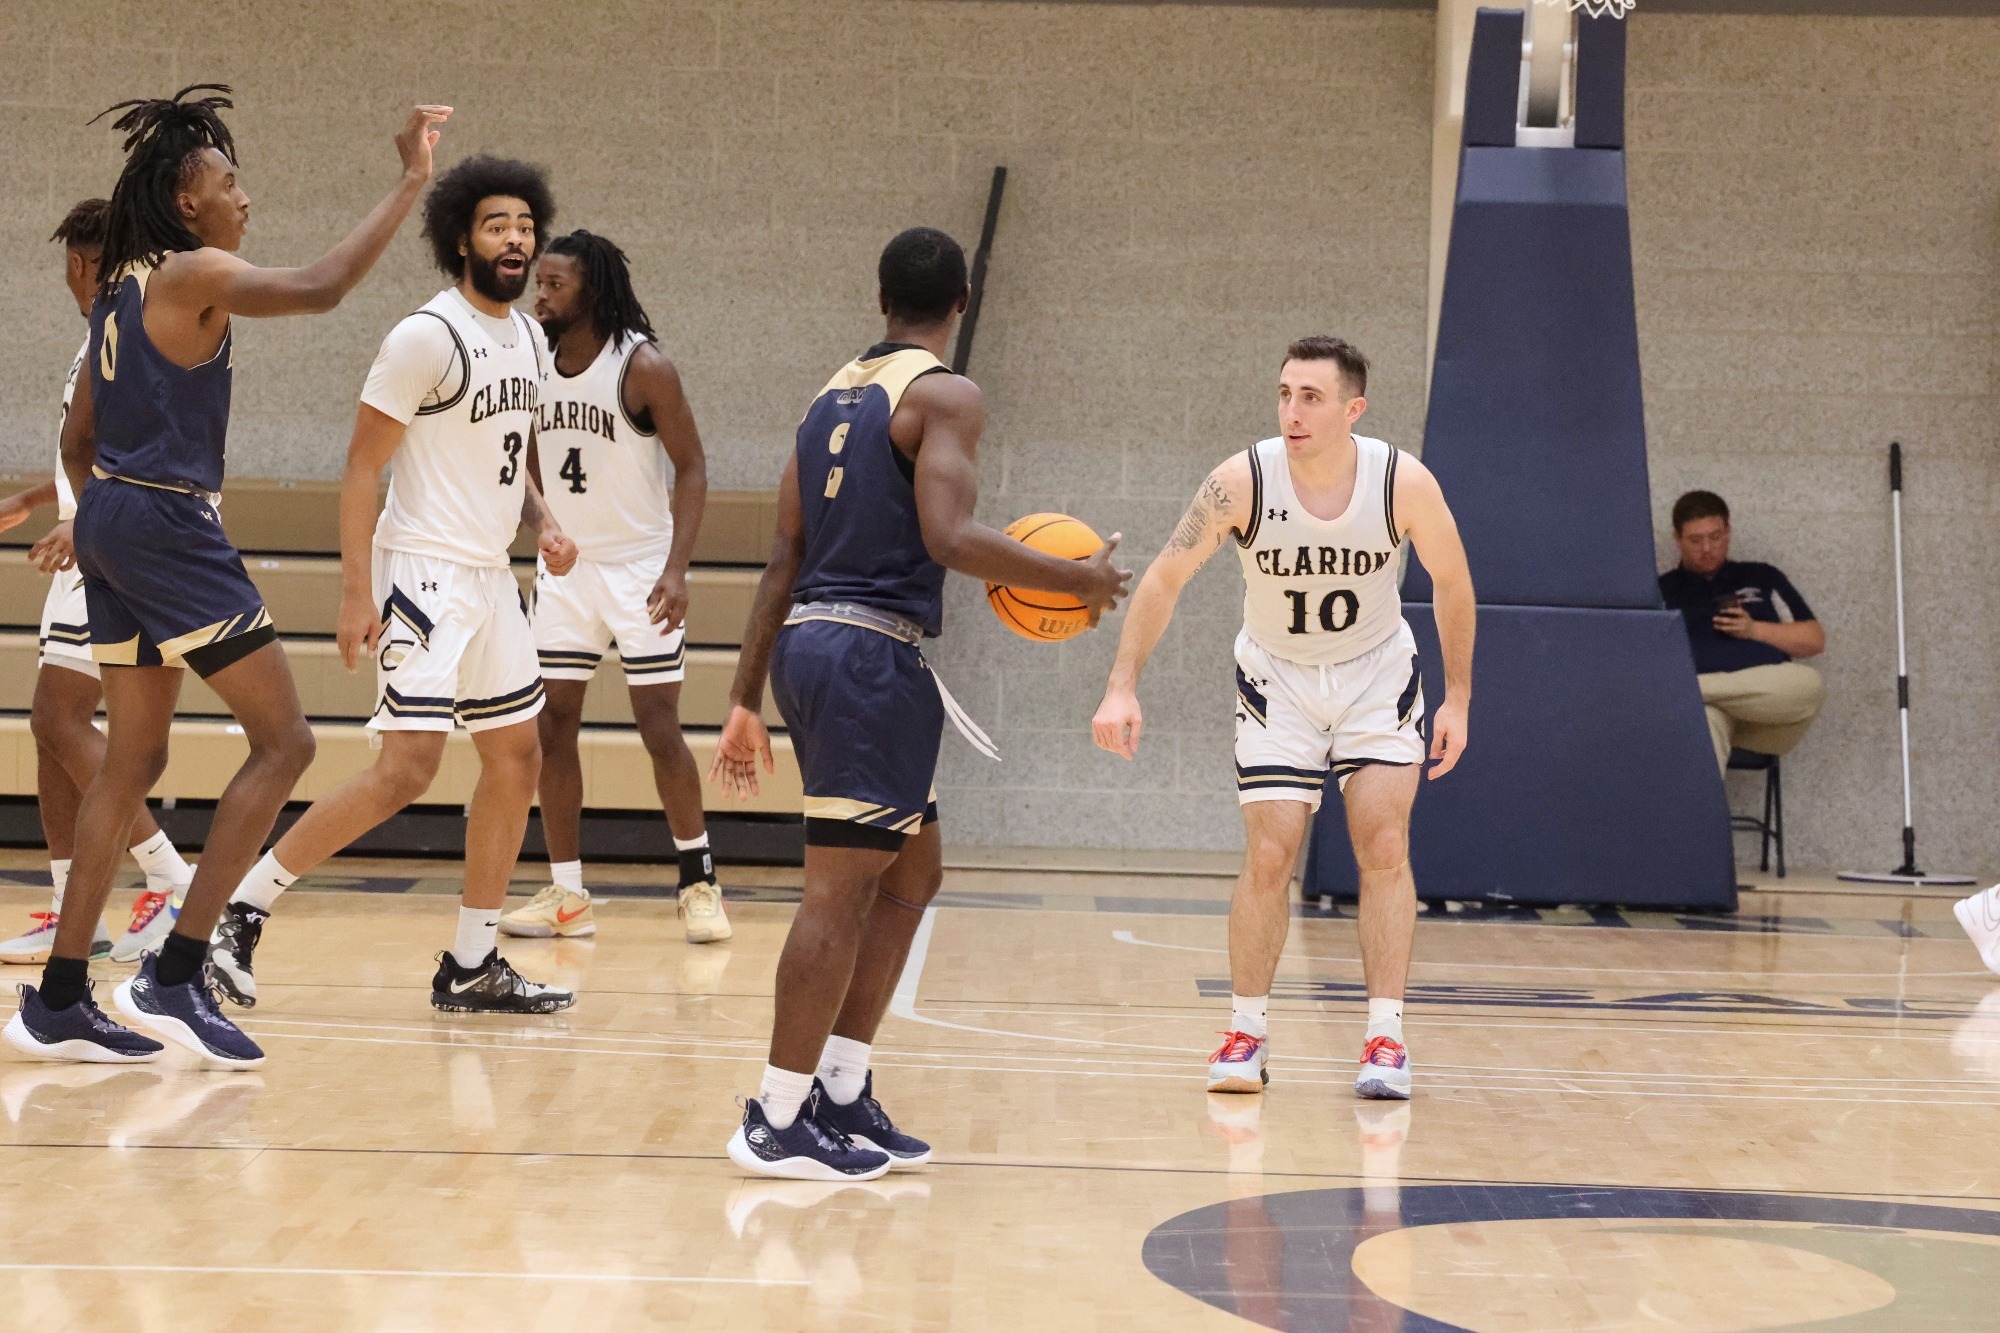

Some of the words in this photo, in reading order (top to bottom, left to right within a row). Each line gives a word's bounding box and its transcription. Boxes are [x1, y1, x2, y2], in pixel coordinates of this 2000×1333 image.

[470, 376, 539, 423] CLARIO
[499, 431, 523, 486] 3
[559, 447, 587, 494] 4
[1256, 546, 1391, 576] CLARION
[1283, 589, 1360, 634] 10
